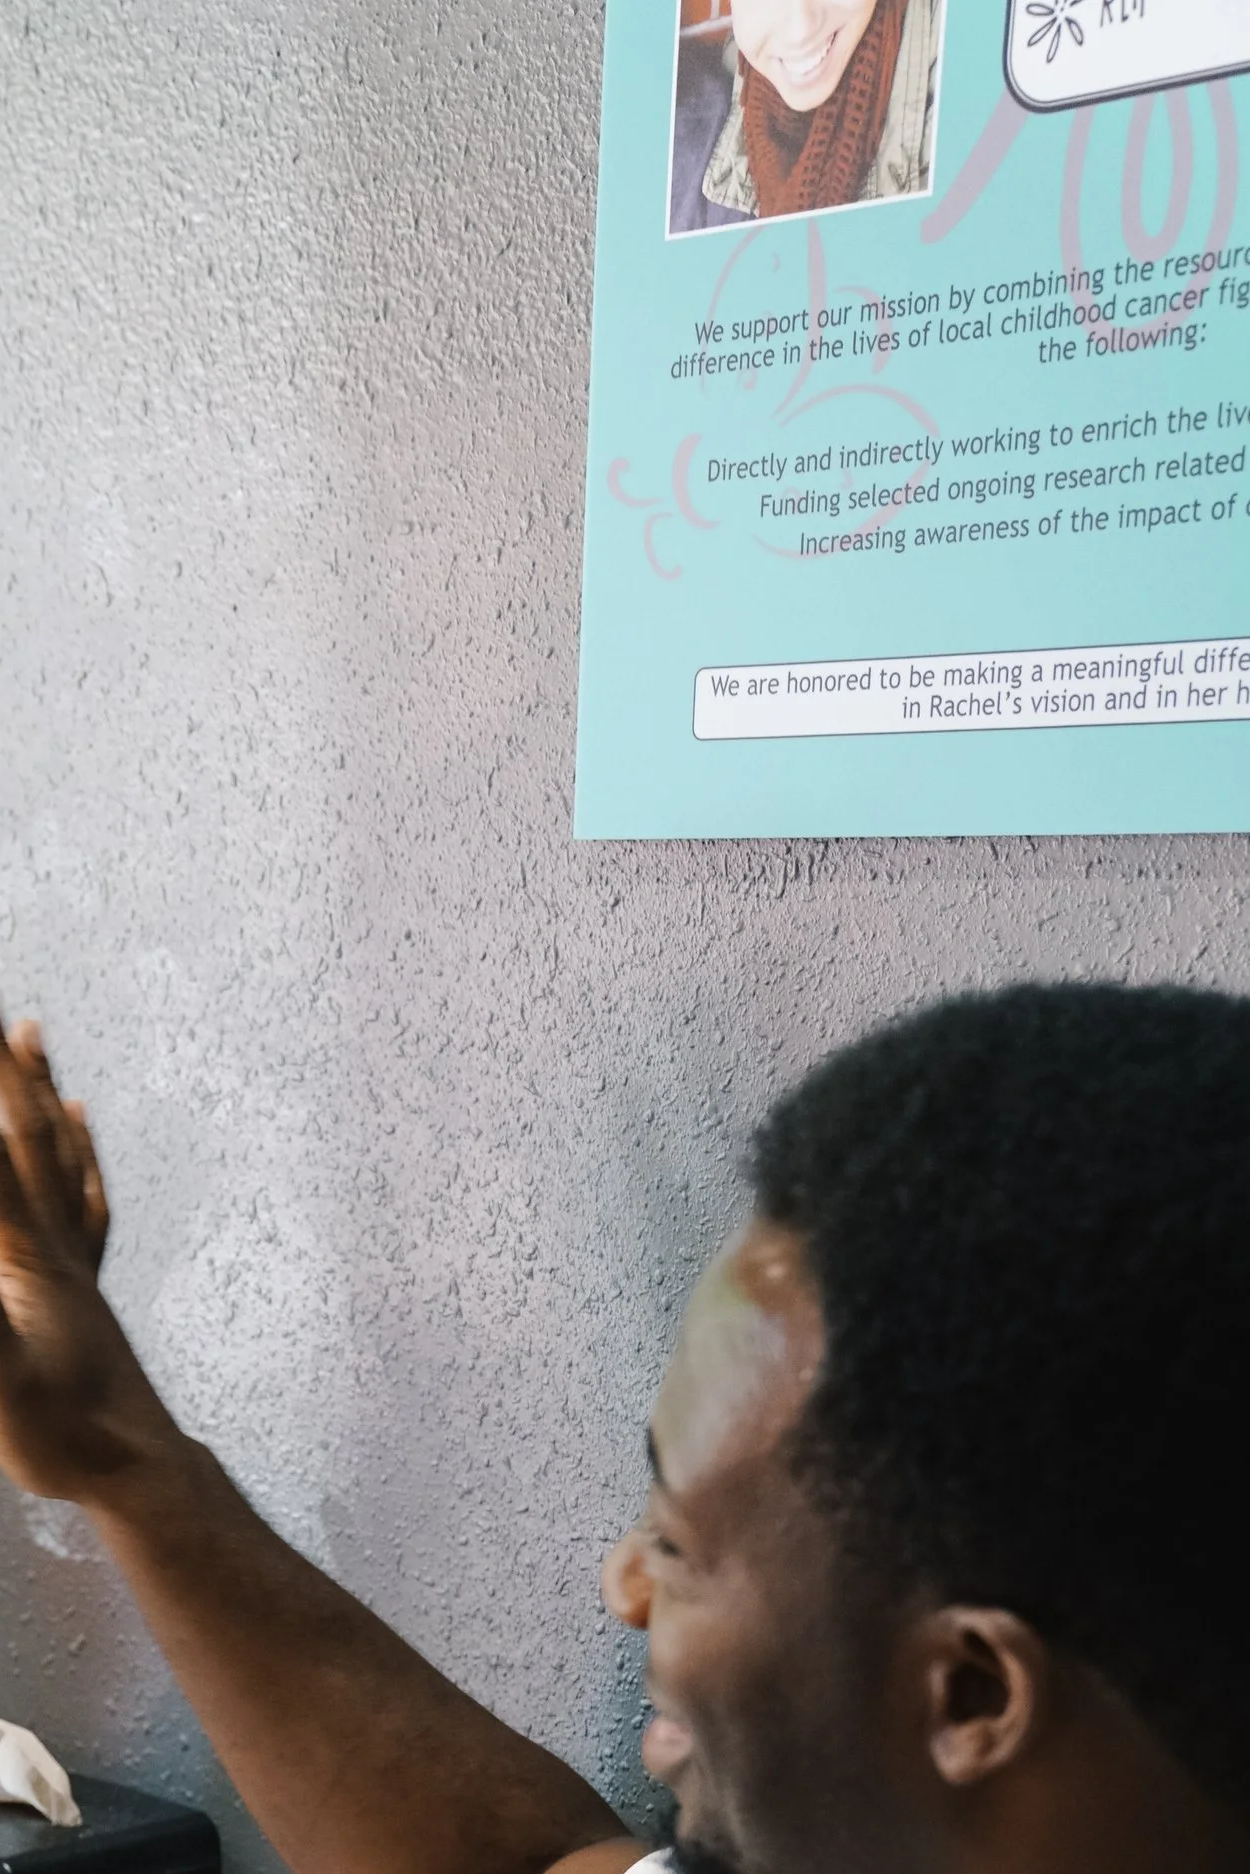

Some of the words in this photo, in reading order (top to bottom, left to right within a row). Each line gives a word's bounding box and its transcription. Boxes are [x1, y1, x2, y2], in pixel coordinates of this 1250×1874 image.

[671, 348, 775, 379] difference
[783, 341, 800, 365] in
[810, 336, 844, 361] the
[852, 330, 900, 356] lives
[908, 323, 931, 348] of
[939, 312, 992, 344] local
[1001, 294, 1116, 335] childhood
[1125, 286, 1210, 318] cancer
[1219, 277, 1250, 309] fig
[695, 320, 724, 345] We
[731, 309, 809, 343] support
[817, 305, 852, 329] our
[860, 291, 940, 323] mission
[949, 285, 976, 314] by
[983, 267, 1104, 305] combining
[1114, 257, 1154, 286] the
[1039, 337, 1077, 364] the
[1086, 322, 1207, 358] following:
[708, 452, 788, 482] Directly
[794, 446, 832, 474] and
[839, 435, 943, 469] indirectly
[951, 427, 1041, 457] working
[1050, 424, 1073, 447] to
[1081, 411, 1157, 443] enrich
[1167, 406, 1207, 434] the
[1217, 401, 1250, 429] liv
[760, 490, 840, 517] Funding
[848, 477, 940, 510] selected
[948, 471, 1035, 503] ongoing
[1044, 457, 1145, 492] research
[1155, 445, 1246, 480] related
[800, 526, 906, 555] Increasing
[914, 518, 1029, 546] awareness
[1038, 509, 1063, 536] of
[1071, 506, 1109, 533] the
[1119, 499, 1201, 532] impact
[1211, 492, 1238, 520] of
[711, 675, 740, 697] We
[747, 676, 779, 696] are
[787, 667, 871, 694] honored
[880, 668, 901, 690] to
[910, 665, 935, 688] be
[944, 661, 1022, 689] making
[1031, 664, 1043, 683] a
[1052, 650, 1184, 683] meaningful
[1194, 646, 1250, 674] diffe
[902, 696, 921, 719] in
[1031, 689, 1094, 713] vision
[1104, 685, 1147, 711] and
[1157, 684, 1177, 709] in
[1187, 682, 1228, 707] her
